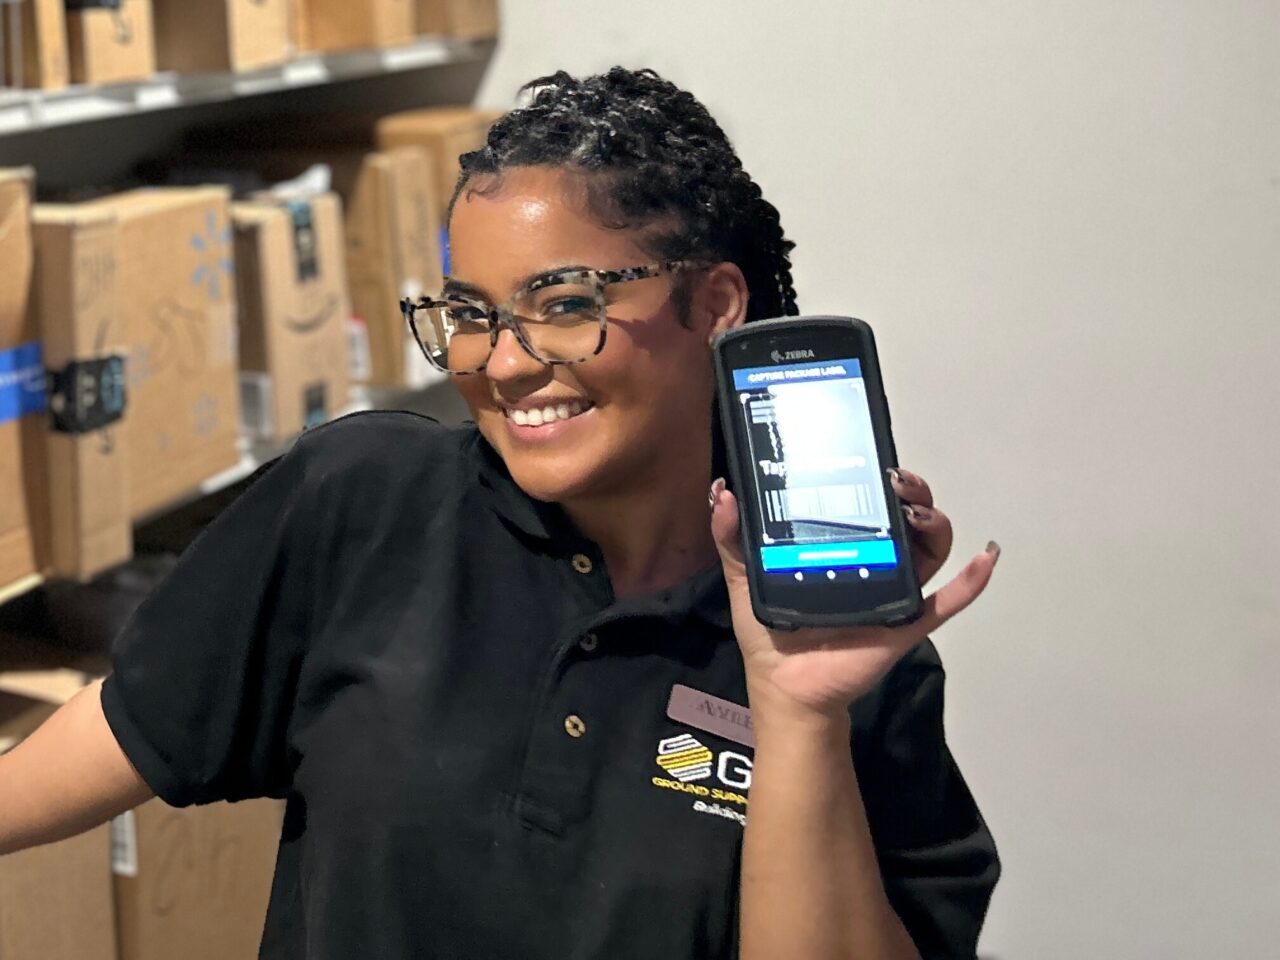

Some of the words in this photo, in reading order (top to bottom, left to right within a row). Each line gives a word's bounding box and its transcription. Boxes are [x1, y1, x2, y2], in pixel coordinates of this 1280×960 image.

[784, 349, 815, 360] ZEBRA
[747, 371, 784, 384] CAPTURE
[784, 367, 821, 380] PACKAGE
[821, 365, 847, 377] LABEL
[652, 776, 710, 796] GROUND
